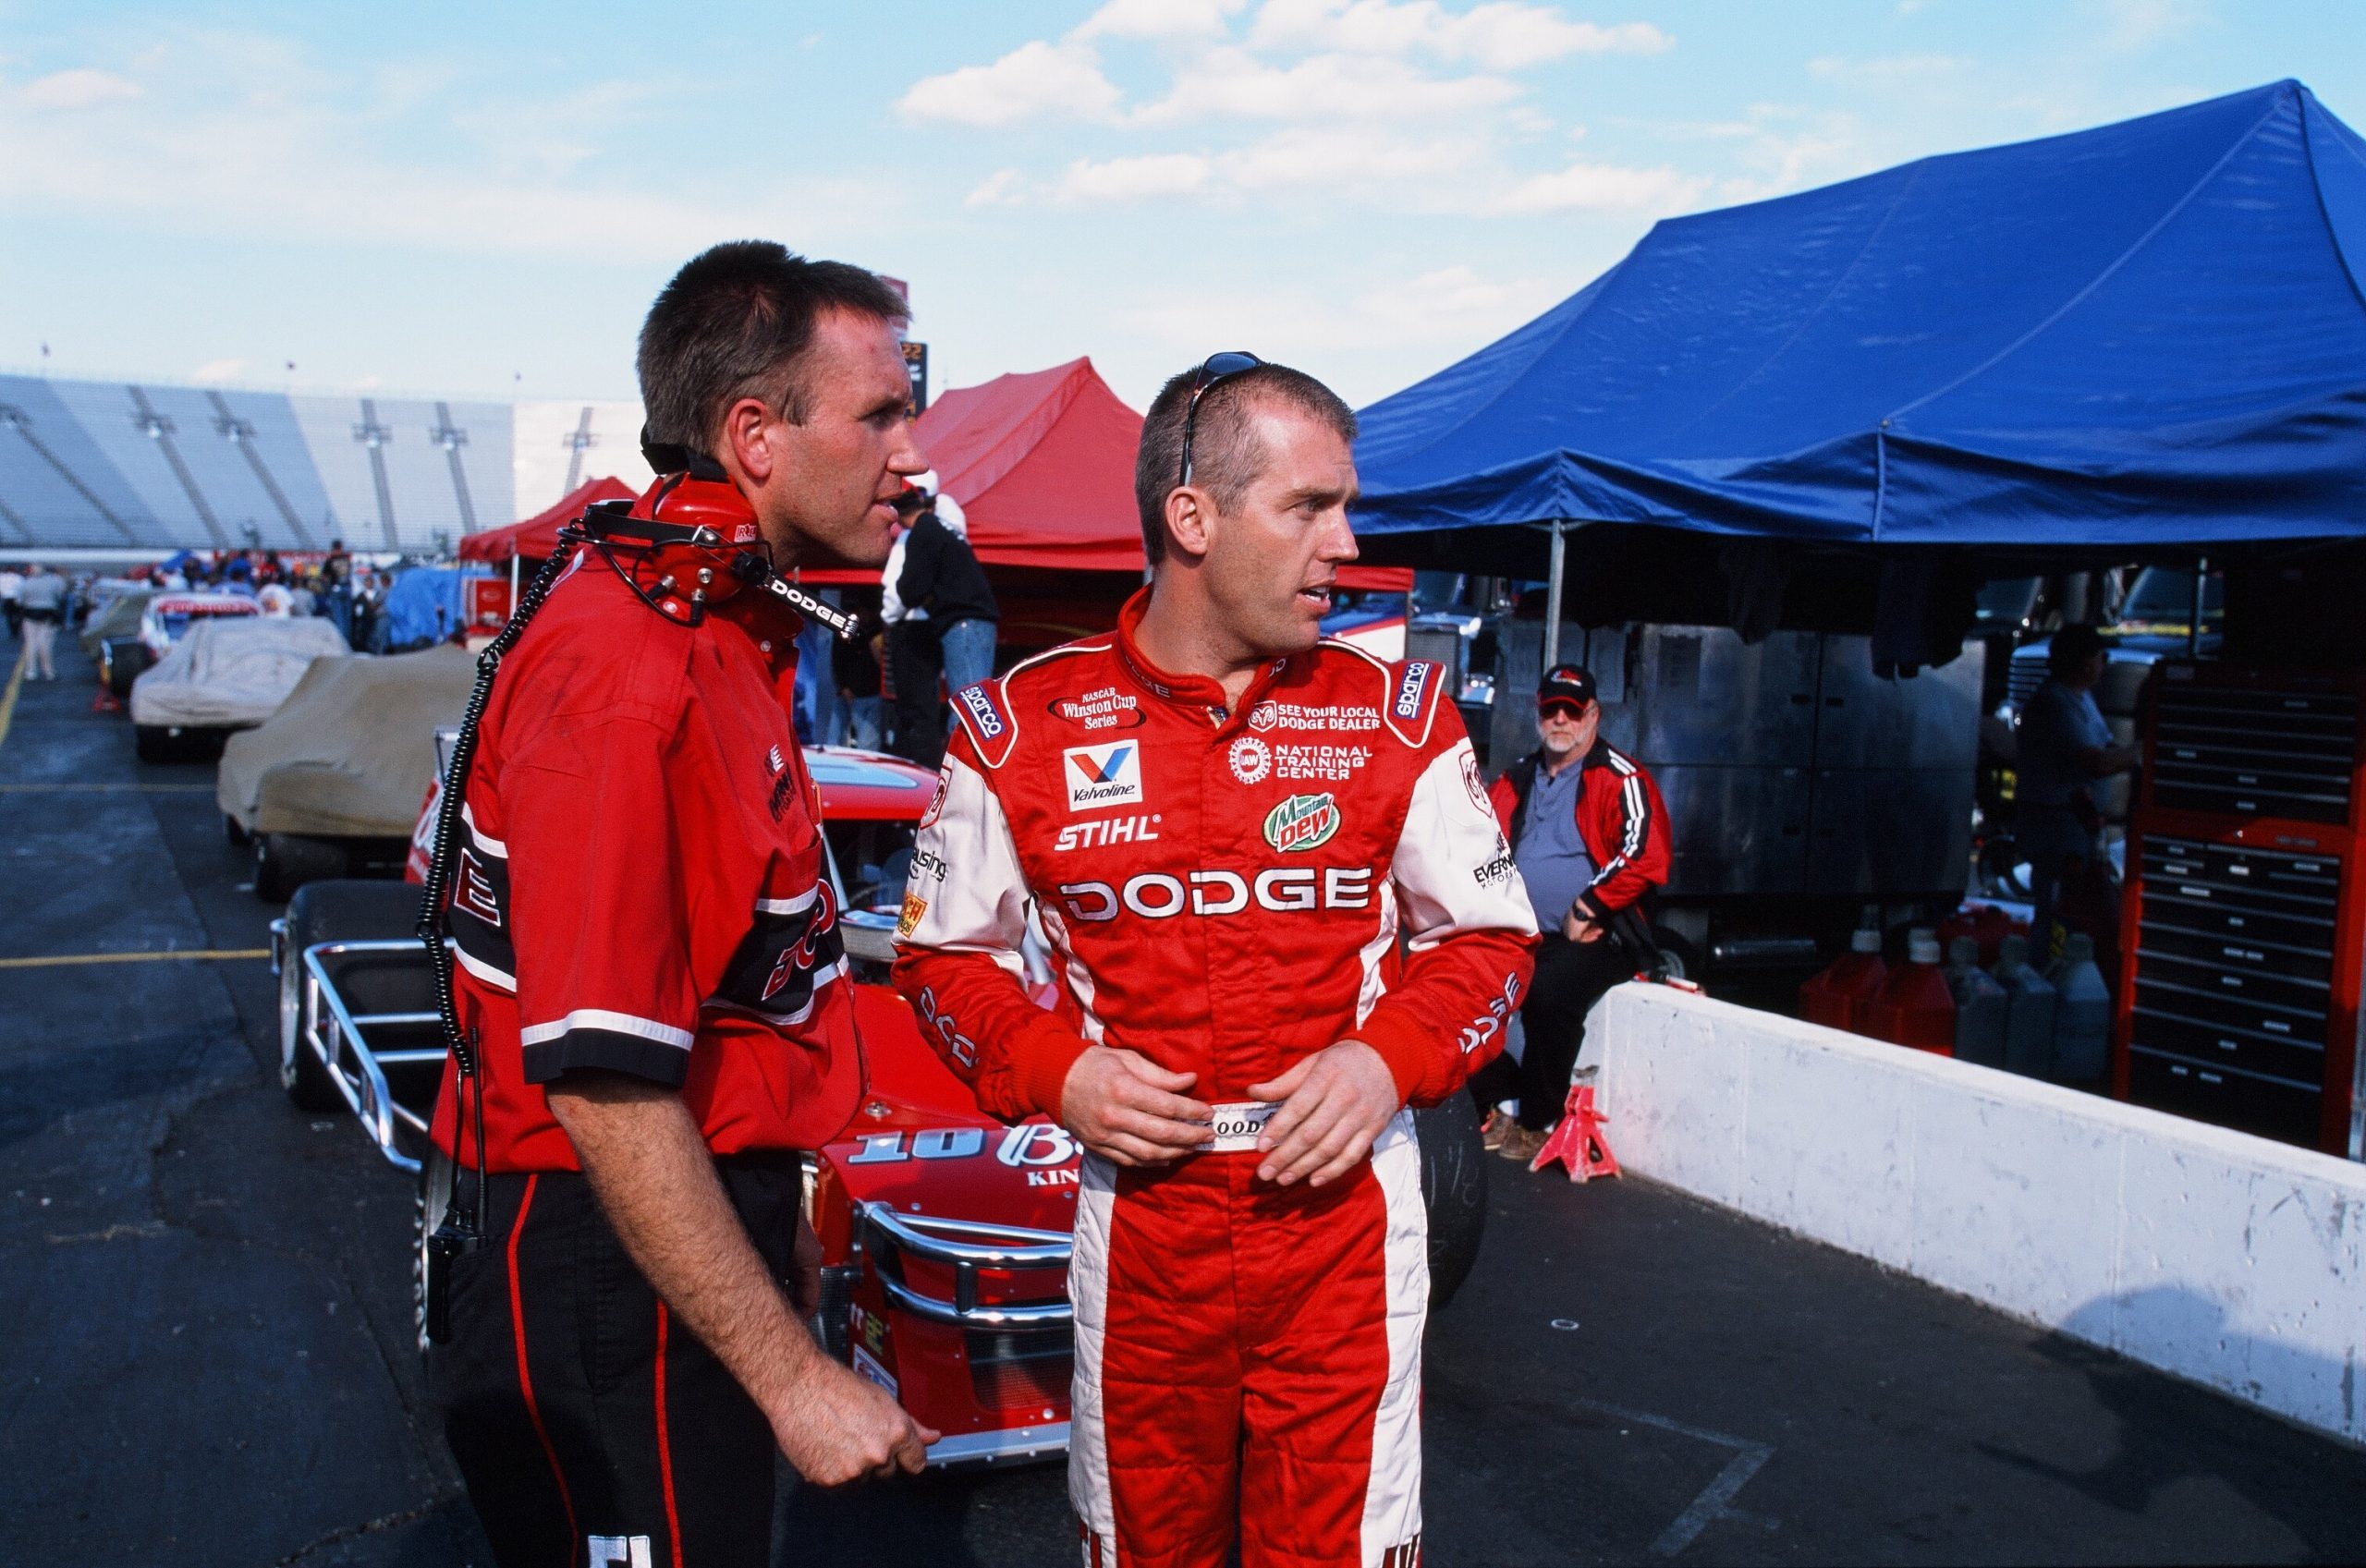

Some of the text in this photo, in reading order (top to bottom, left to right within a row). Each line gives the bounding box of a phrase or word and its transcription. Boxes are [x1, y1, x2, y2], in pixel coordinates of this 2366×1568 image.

[771, 578, 847, 629] DODGE
[1082, 687, 1116, 703] NASCAR
[1397, 662, 1429, 718] sparco
[962, 686, 1003, 738] sparco
[1063, 694, 1137, 718] Winston Cup
[1278, 704, 1380, 719] SEE YOUR LOCAL
[1085, 714, 1118, 730] Series
[1278, 718, 1381, 730] DODGE DEALER
[1275, 745, 1373, 758] NATIONAL
[1274, 756, 1365, 769] TRAINING
[1276, 767, 1350, 781] CENTER
[1073, 784, 1135, 803] Valvoline
[1473, 853, 1514, 883] EVERN
[1059, 867, 1372, 921] DODGE
[1026, 1168, 1080, 1187] KIN
